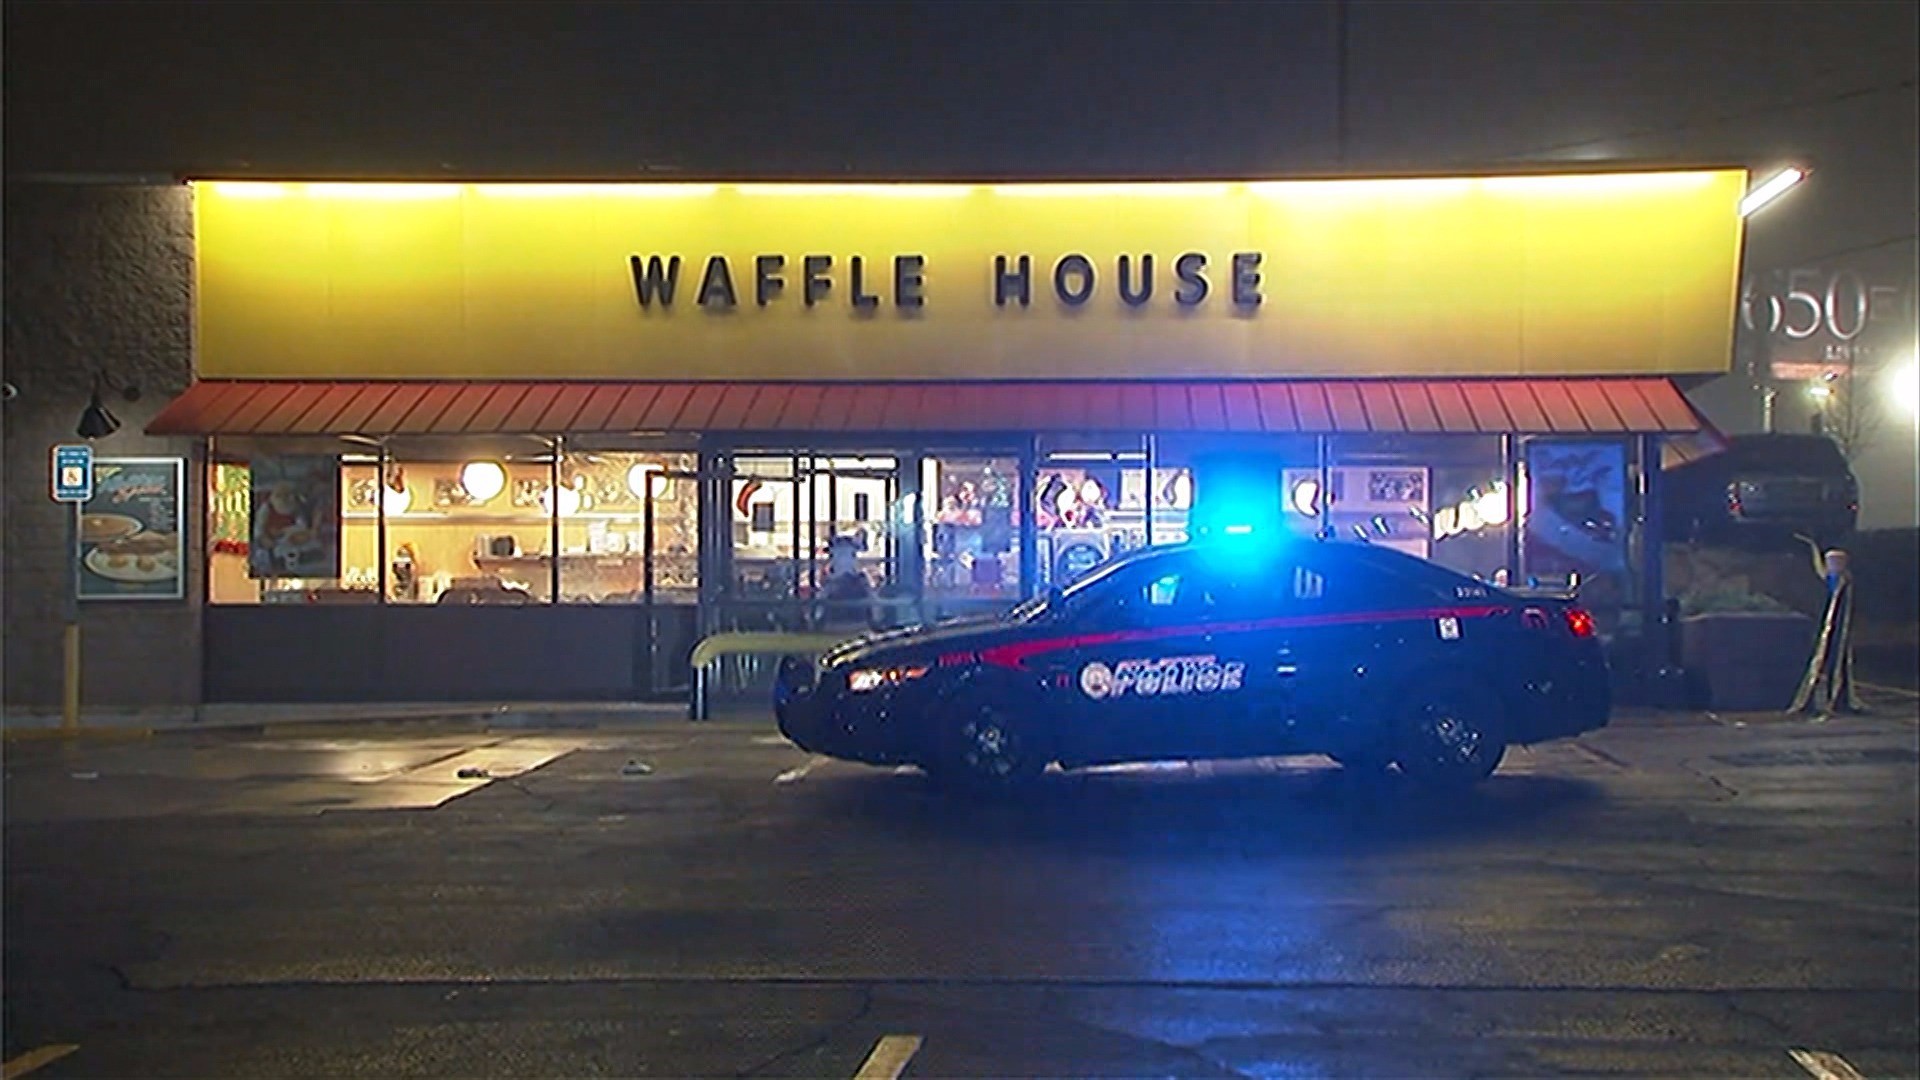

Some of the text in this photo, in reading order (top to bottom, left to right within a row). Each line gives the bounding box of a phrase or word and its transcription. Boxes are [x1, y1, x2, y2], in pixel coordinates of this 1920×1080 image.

[630, 252, 1265, 308] WAFFLE HOUSE
[1110, 660, 1246, 698] POLICE
